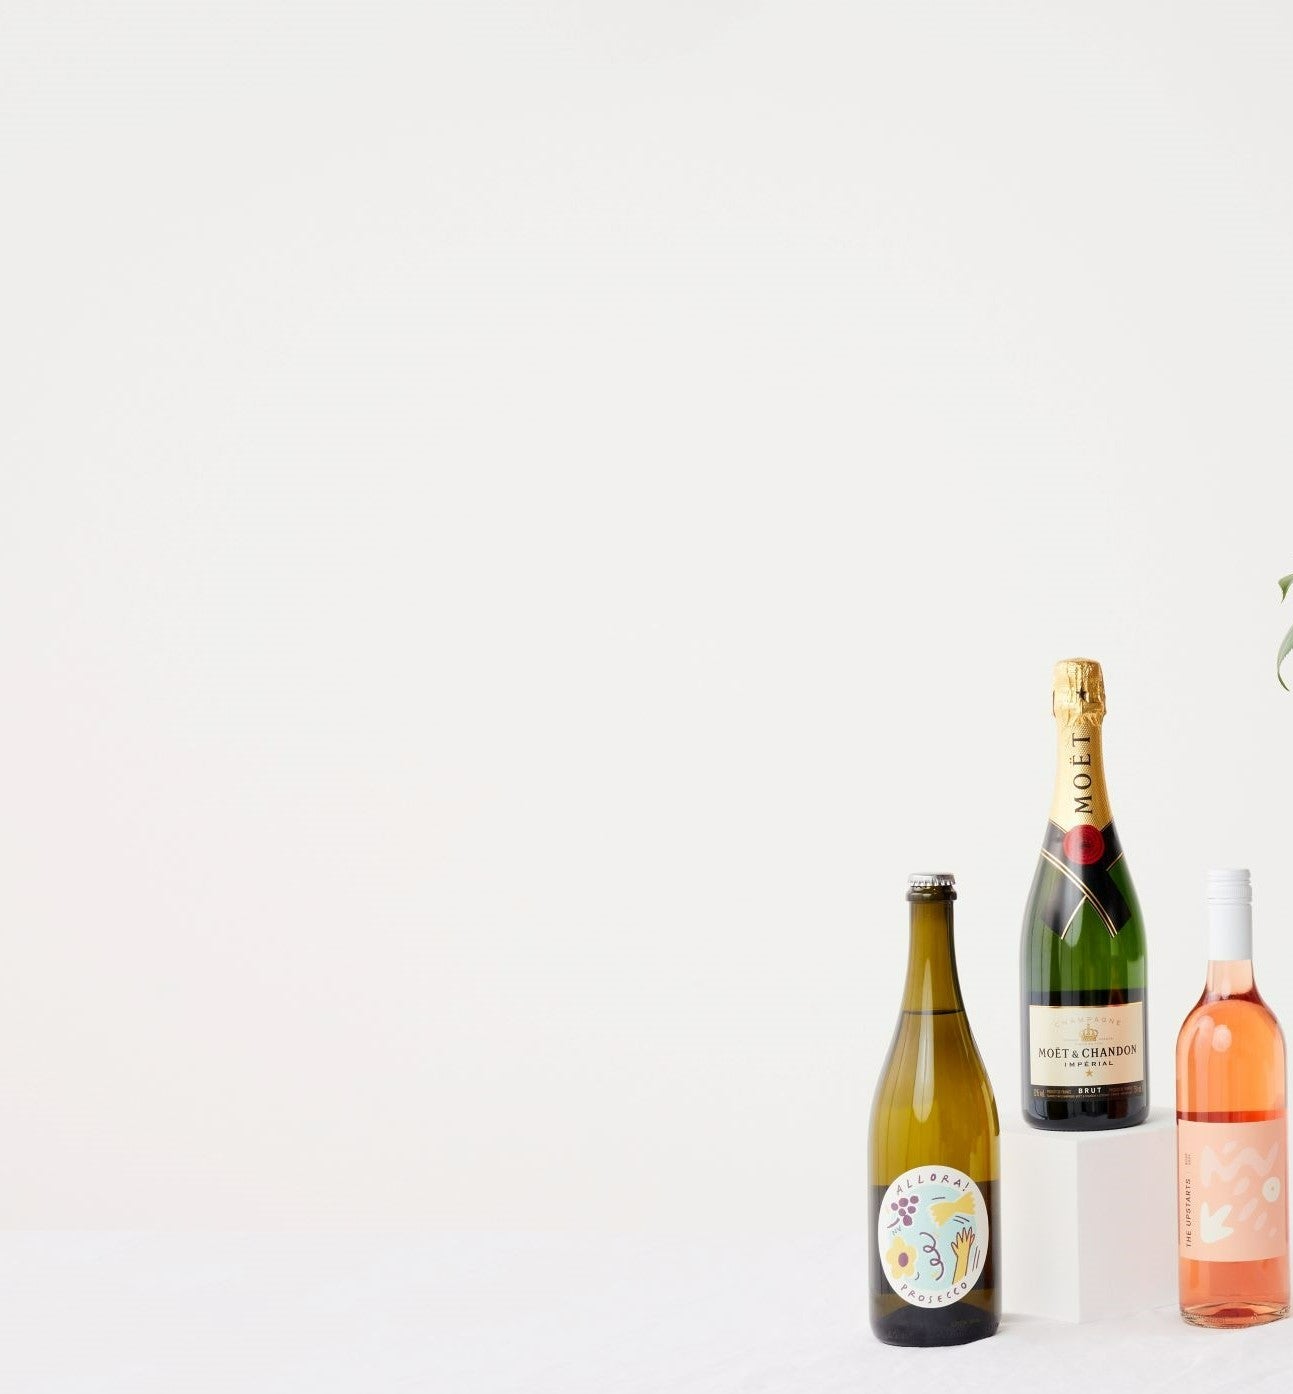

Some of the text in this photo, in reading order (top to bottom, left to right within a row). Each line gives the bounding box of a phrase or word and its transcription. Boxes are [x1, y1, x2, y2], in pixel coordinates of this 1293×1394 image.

[1069, 732, 1093, 814] MOËT
[1038, 1044, 1137, 1058] MOËT & CHANDON
[896, 1173, 970, 1195] ALLORA!
[900, 1282, 967, 1304] PROSECCO
